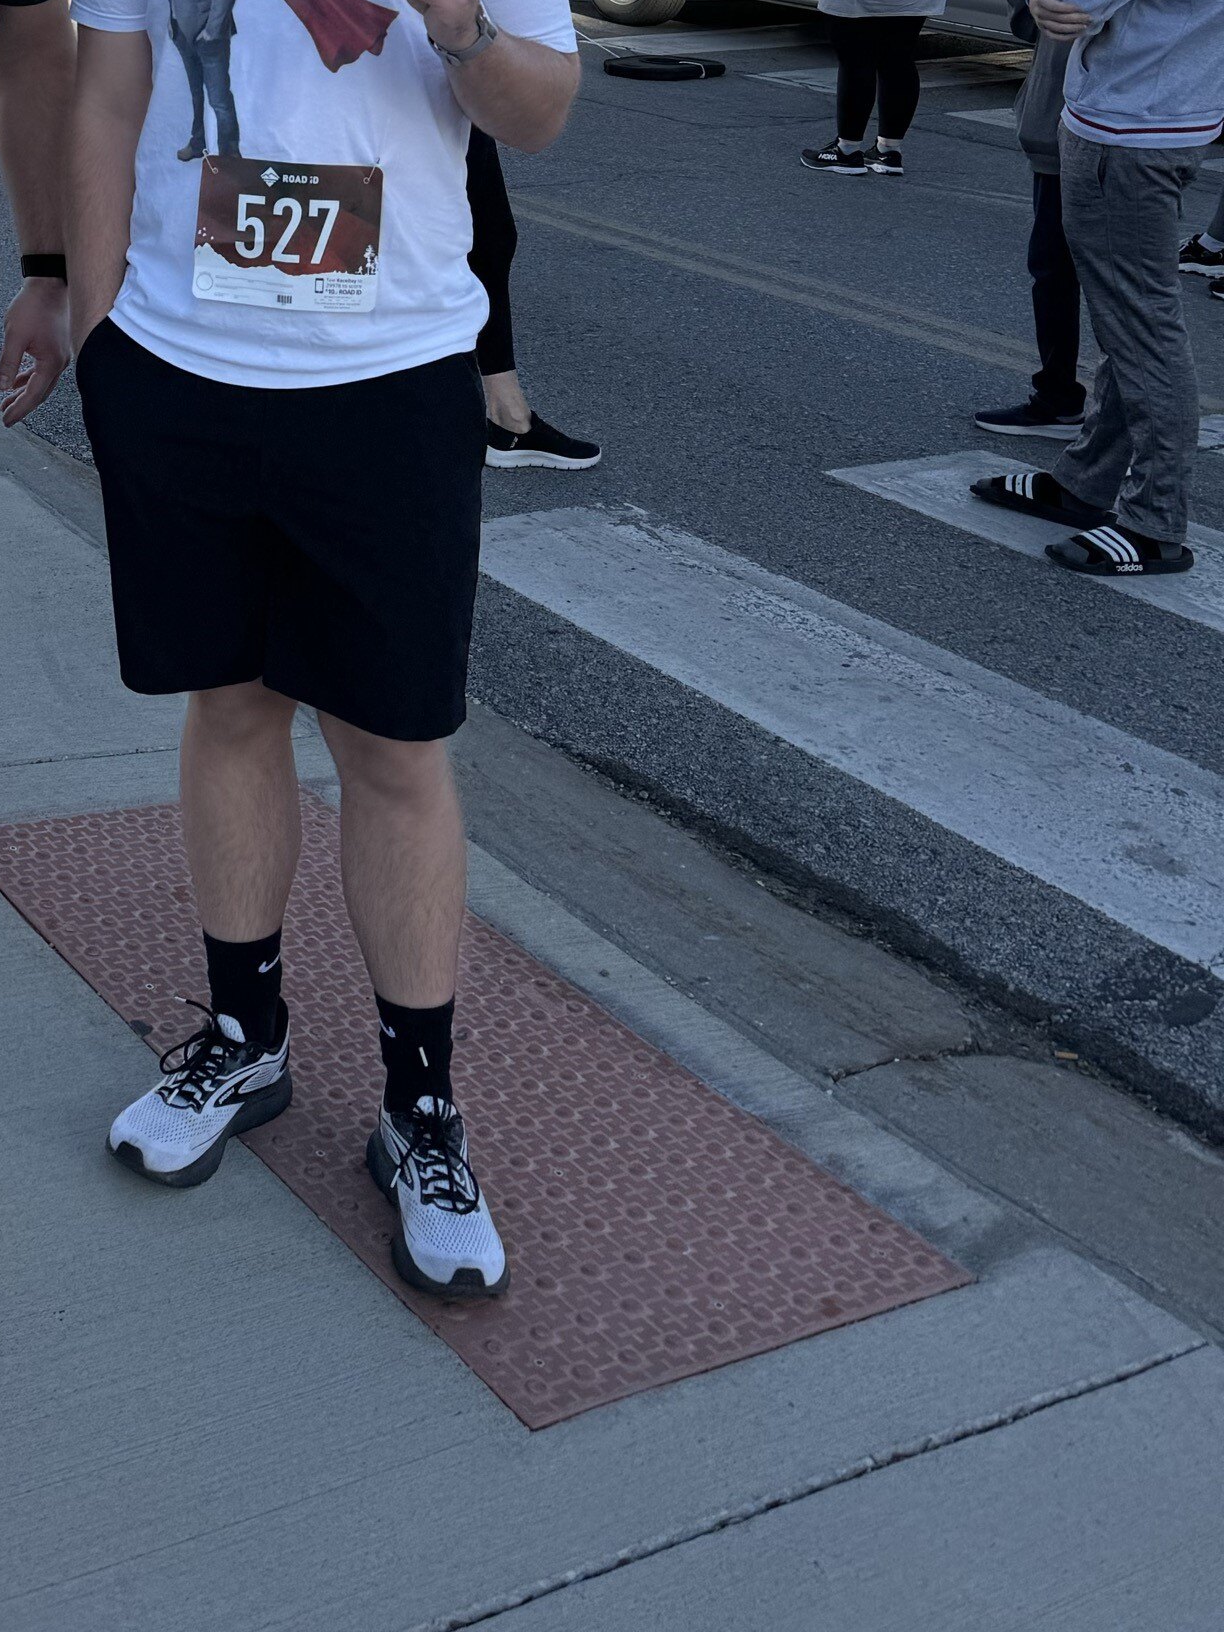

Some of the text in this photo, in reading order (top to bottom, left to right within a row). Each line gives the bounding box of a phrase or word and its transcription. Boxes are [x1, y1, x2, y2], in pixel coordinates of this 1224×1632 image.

[817, 153, 838, 161] HOKA
[282, 173, 308, 185] ROAD
[234, 193, 340, 265] 527
